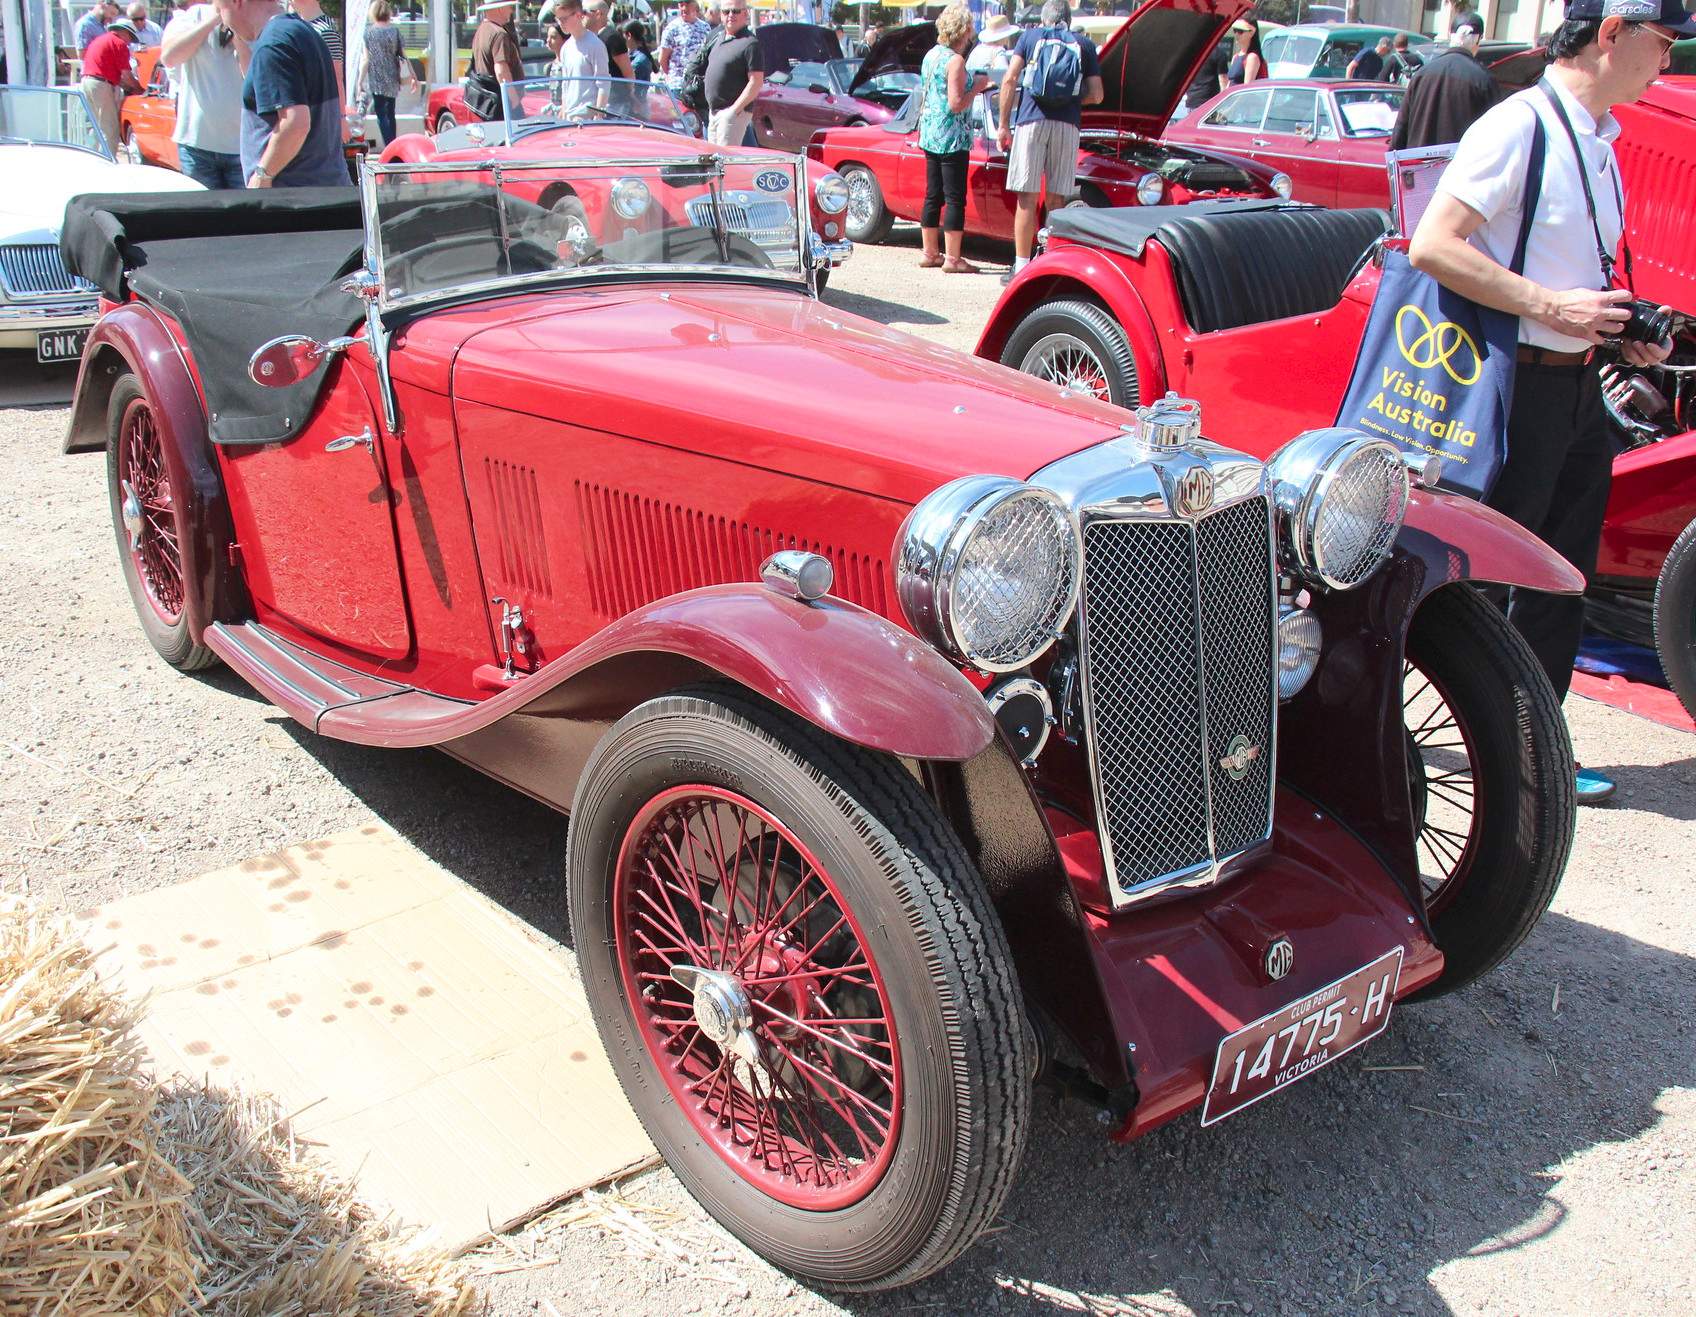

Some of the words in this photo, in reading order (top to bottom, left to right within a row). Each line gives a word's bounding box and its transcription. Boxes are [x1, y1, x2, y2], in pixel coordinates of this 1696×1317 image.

[1610, 6, 1654, 14] carsales
[1382, 366, 1447, 412] Vision
[1367, 392, 1476, 447] Australia
[1391, 430, 1406, 441] Low
[1425, 446, 1469, 464] Opportunity.
[1184, 469, 1212, 509] MG
[1267, 940, 1293, 980] MG
[1290, 1000, 1312, 1020] CLUB
[1312, 984, 1342, 1008] PERMIT
[1275, 1049, 1329, 1086] VICTORIA
